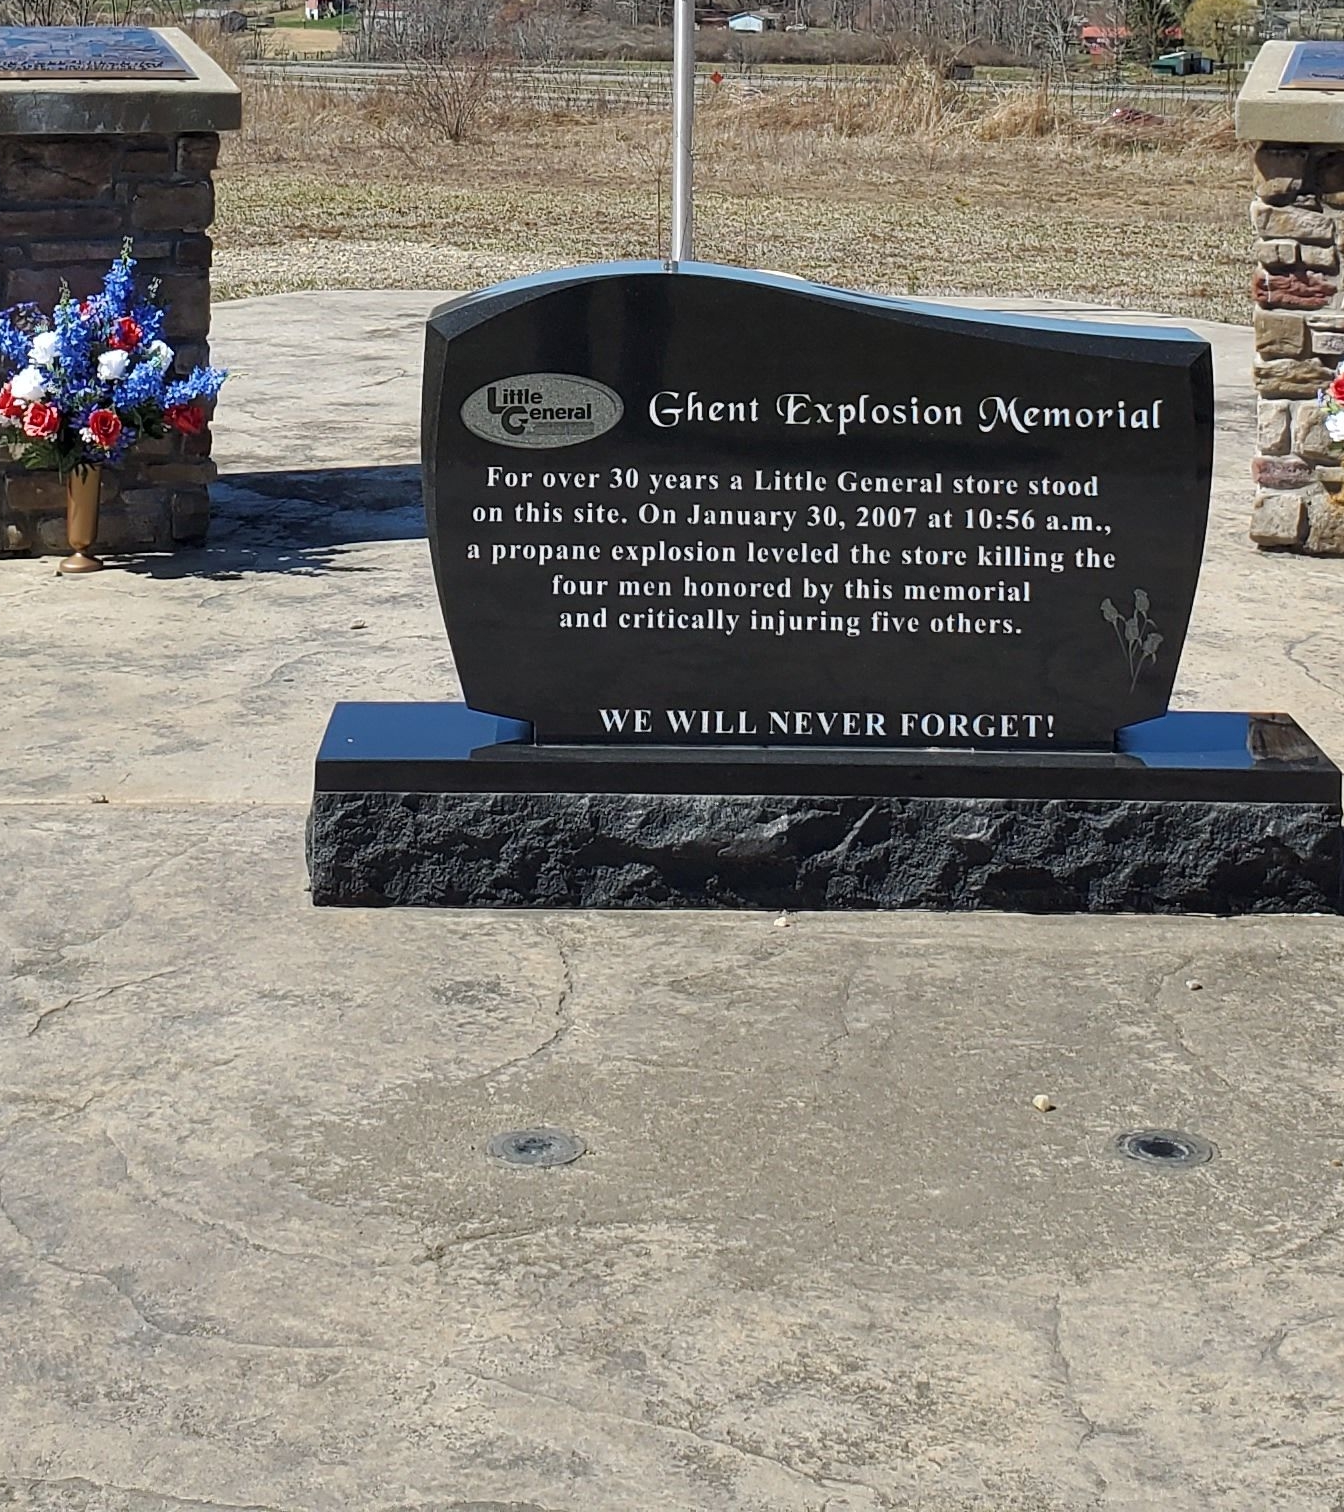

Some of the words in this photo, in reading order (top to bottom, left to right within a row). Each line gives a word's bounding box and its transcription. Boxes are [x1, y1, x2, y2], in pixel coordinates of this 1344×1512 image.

[487, 387, 543, 414] Little
[649, 391, 759, 428] Ghent
[776, 393, 963, 436] Explosion
[978, 396, 1163, 434] Memorial
[501, 404, 592, 435] General
[486, 466, 533, 488] For
[542, 472, 601, 489] over
[609, 467, 639, 489] 30
[649, 473, 719, 495] years
[729, 475, 743, 491] a
[754, 469, 827, 492] Little
[837, 470, 942, 494] General
[953, 474, 1019, 495] store
[1028, 475, 1099, 497] stood
[472, 506, 503, 522] on
[514, 501, 563, 523] this
[573, 502, 628, 524] site.
[638, 503, 677, 525] On
[686, 504, 797, 532] January
[806, 505, 846, 531] 30,
[856, 506, 917, 528] 2007
[927, 509, 953, 529] at
[965, 508, 1035, 530] 10:56
[1045, 515, 1112, 536] a.m.,
[467, 544, 481, 559] a
[491, 544, 601, 566] propane
[611, 540, 736, 567] explosion
[747, 541, 839, 564] leveled
[849, 543, 891, 565] the
[901, 545, 967, 566] store
[977, 545, 1065, 573] killing
[1075, 547, 1116, 569] the
[552, 574, 609, 596] four
[618, 580, 672, 597] men
[683, 576, 792, 599] honored
[803, 577, 834, 605] by
[844, 578, 893, 600] this
[904, 580, 1031, 602] memorial
[559, 607, 607, 628] and
[618, 607, 740, 636] critically
[750, 609, 861, 637] injuring
[871, 610, 920, 633] five
[930, 612, 1022, 635] others.
[598, 708, 652, 733] WE
[665, 709, 757, 734] WILL
[768, 710, 887, 736] NEVER
[901, 713, 1054, 738] FORGET!
